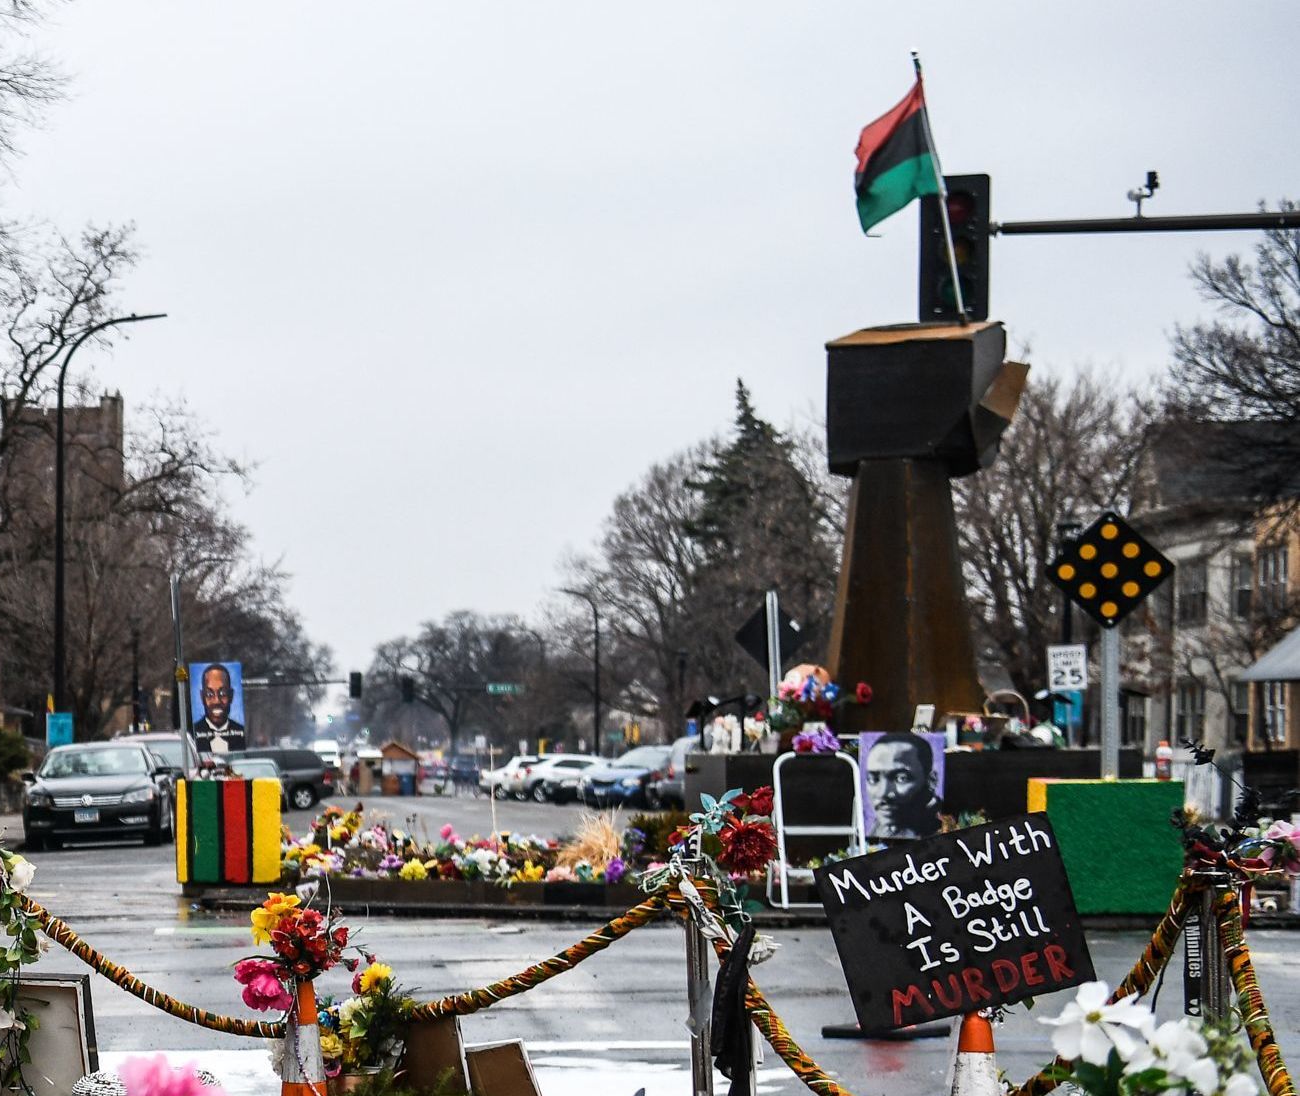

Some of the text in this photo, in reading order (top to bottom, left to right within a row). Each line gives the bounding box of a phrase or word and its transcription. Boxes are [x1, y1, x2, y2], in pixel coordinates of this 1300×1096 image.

[1053, 669, 1083, 685] 25
[828, 821, 1051, 904] Murder With
[904, 877, 1033, 935] A Badge
[906, 906, 1051, 972] Is Still
[890, 944, 1076, 1025] MURDER
